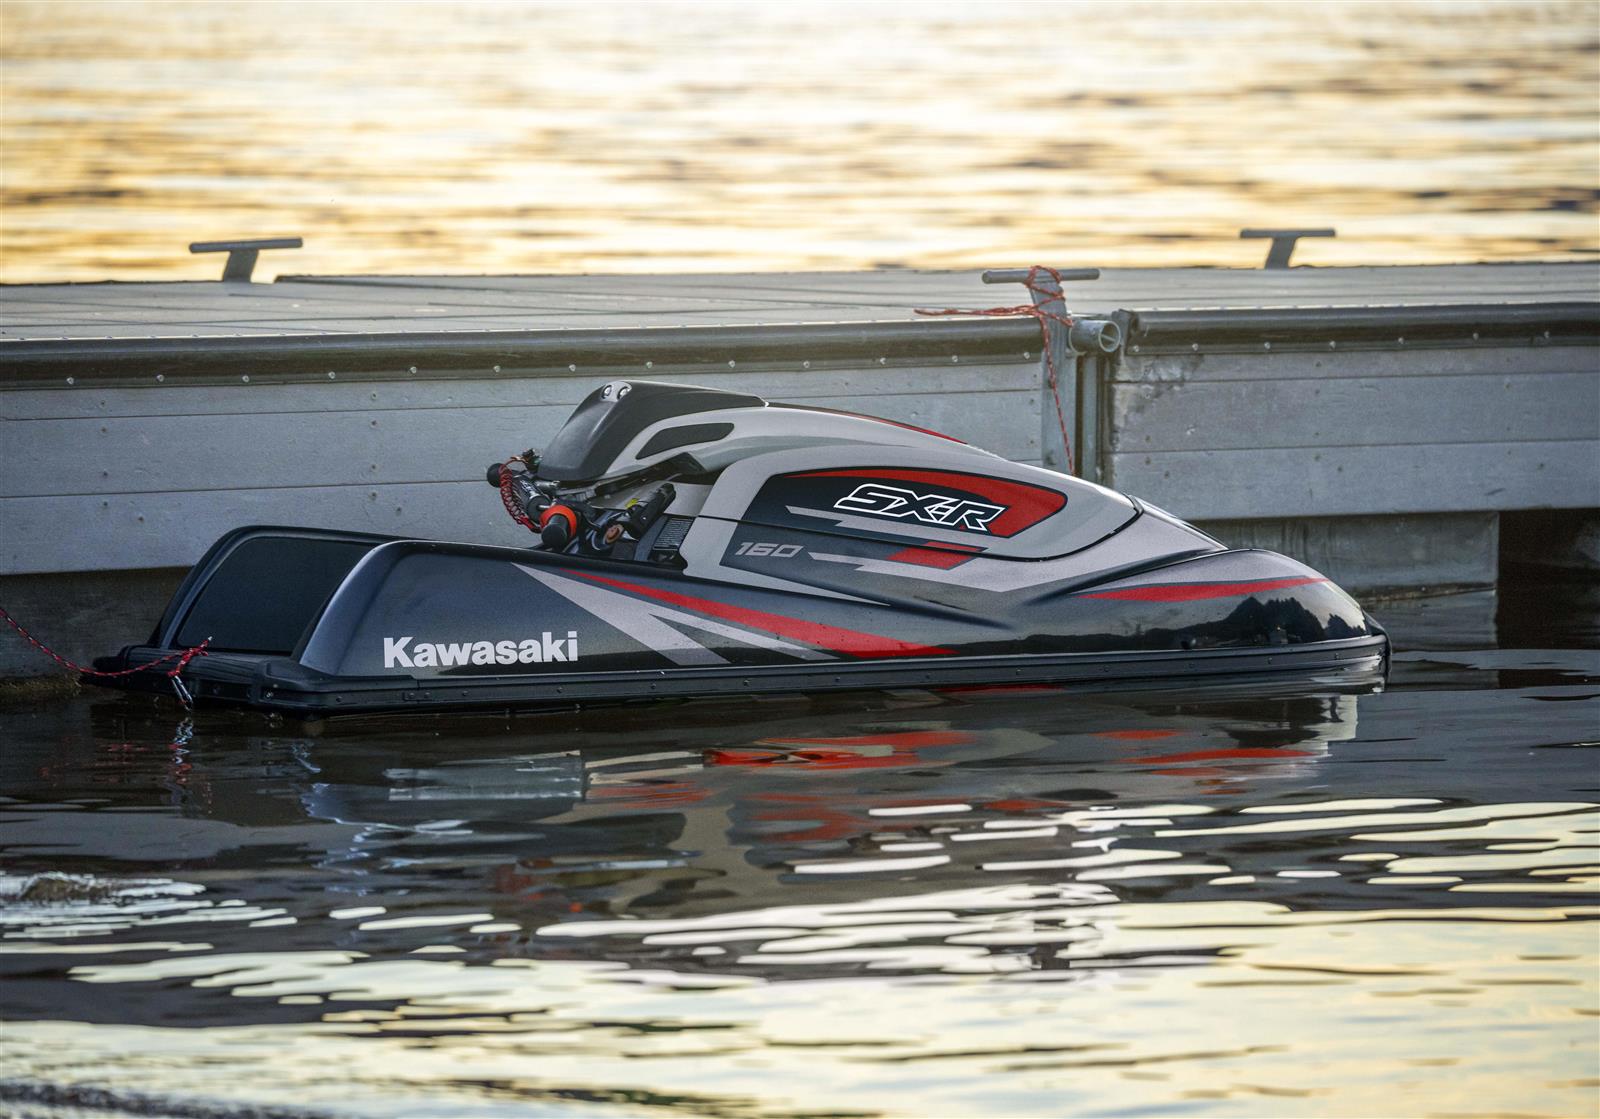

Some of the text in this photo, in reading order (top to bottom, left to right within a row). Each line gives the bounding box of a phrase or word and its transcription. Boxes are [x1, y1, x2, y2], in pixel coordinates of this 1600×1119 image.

[833, 483, 1006, 531] SX-R
[735, 542, 804, 557] 160
[384, 631, 578, 668] Kawasaki
